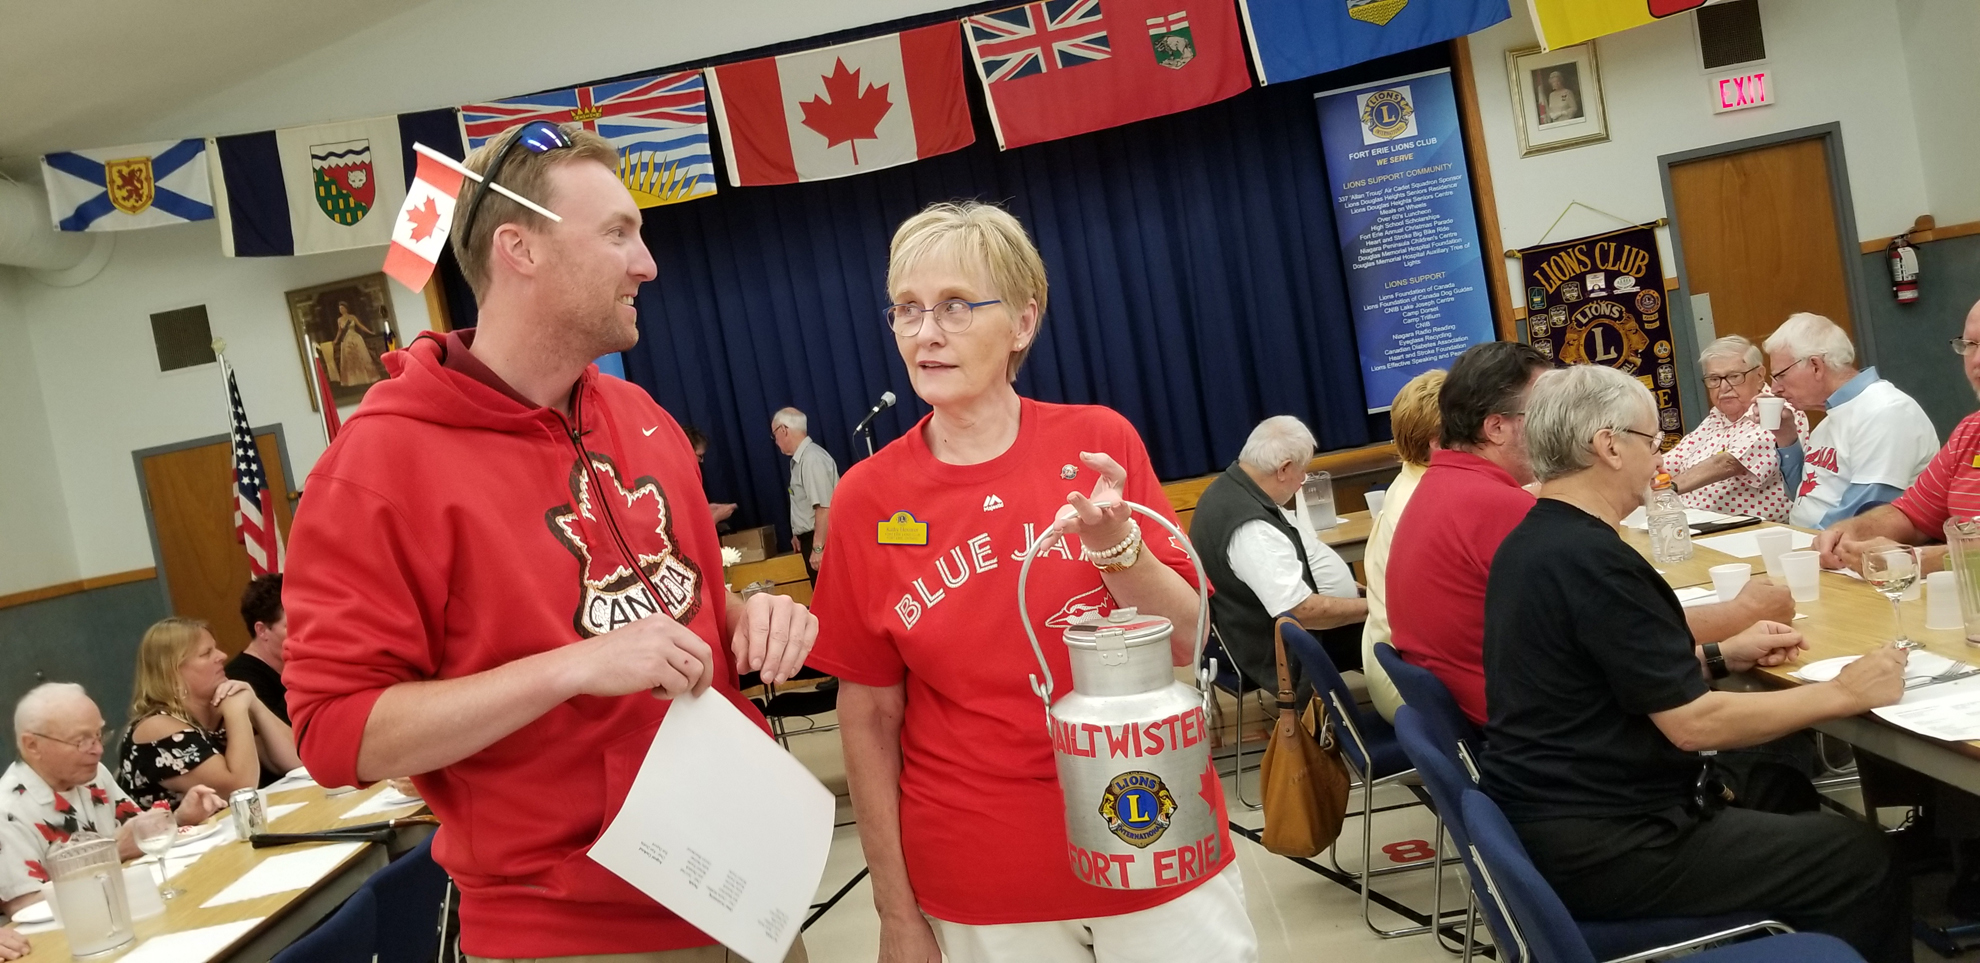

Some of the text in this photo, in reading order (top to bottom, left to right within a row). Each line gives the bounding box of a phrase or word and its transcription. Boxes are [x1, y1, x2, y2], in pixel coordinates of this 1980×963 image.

[1719, 73, 1765, 108] EXIT
[1370, 92, 1400, 105] LIONS
[1380, 105, 1396, 123] L
[1349, 138, 1437, 160] FORT ERIE LIONS CLUB
[1377, 153, 1413, 166] WE SERVE
[1343, 163, 1452, 189] LIONS SUPPORT COMMUNITY
[1411, 180, 1437, 188] Squadron
[1439, 175, 1462, 183] Sponsor
[1360, 197, 1383, 205] Douglas
[1367, 203, 1389, 211] Douglas
[1404, 209, 1431, 218] Luncheon
[1385, 220, 1404, 228] School
[1385, 227, 1403, 235] Annual
[1405, 223, 1432, 231] Christmas
[1358, 254, 1380, 262] Douglas
[1408, 243, 1430, 252] Hospital
[1431, 238, 1462, 247] Foundation
[1402, 251, 1425, 260] Hospital
[1533, 244, 1592, 294] LIONS
[1595, 241, 1650, 278] CLUB
[1385, 272, 1445, 289] LIONS SUPPORT
[1395, 289, 1426, 298] Foundation
[1380, 298, 1410, 307] Foundation
[1415, 300, 1435, 308] Joseph
[1420, 306, 1439, 314] Dorset
[1575, 303, 1621, 324] LIONS
[1415, 321, 1430, 329] CNIB
[1384, 347, 1411, 355] Canadian
[1437, 336, 1468, 345] Association
[1399, 333, 1452, 346] Eyeglass Recycling
[1591, 327, 1618, 361] L
[1436, 344, 1466, 353] Foundation
[1412, 356, 1437, 364] Speaking
[894, 533, 998, 631] BLUE
[1115, 776, 1157, 791] LIONS
[1126, 795, 1150, 822] L
[1382, 840, 1436, 863] 8
[1069, 833, 1217, 888] FORT ERIE
